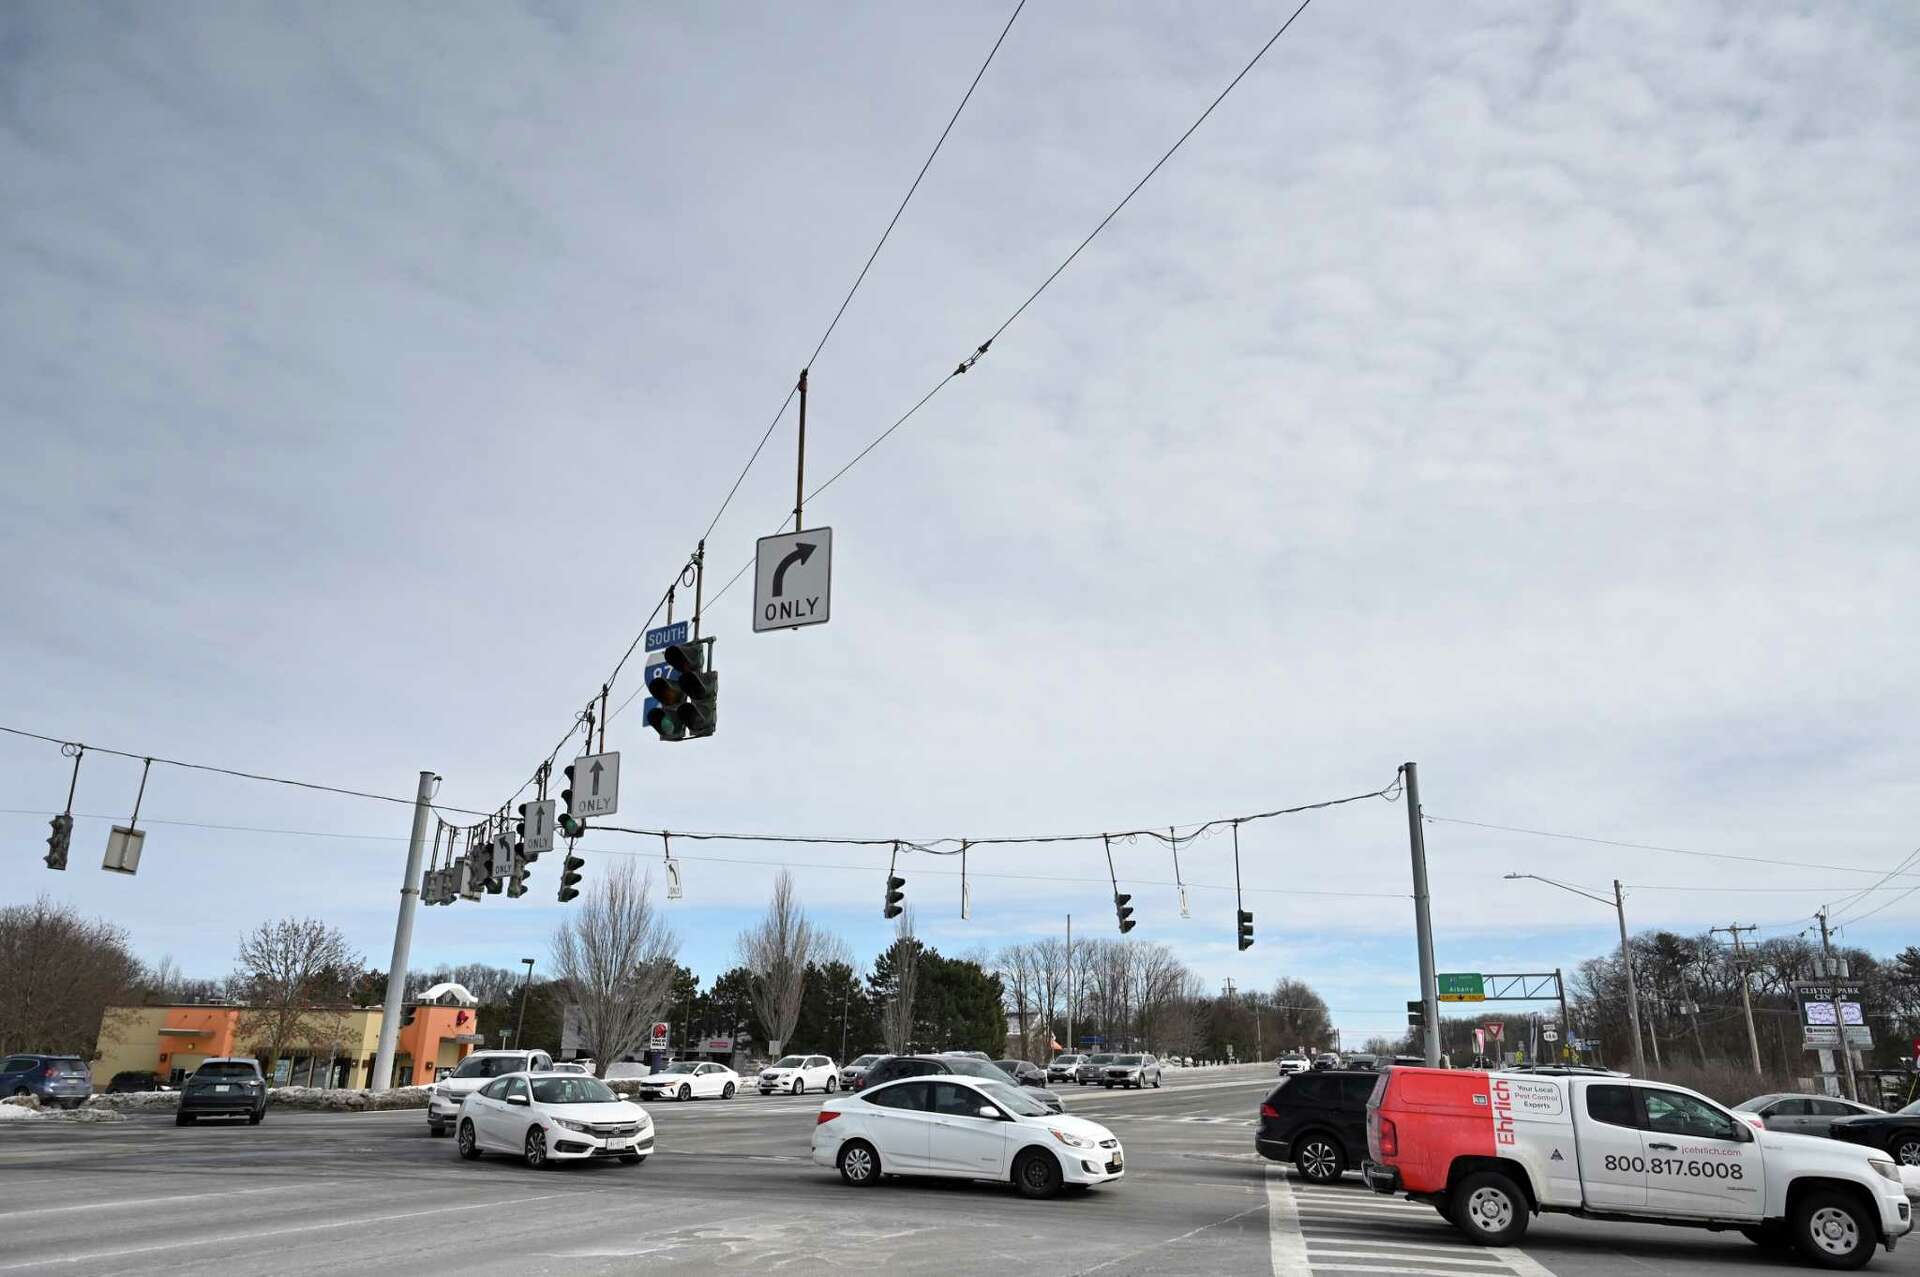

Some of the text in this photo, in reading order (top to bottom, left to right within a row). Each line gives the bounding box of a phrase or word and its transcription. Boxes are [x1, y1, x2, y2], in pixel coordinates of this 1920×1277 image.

[765, 597, 819, 621] ONLY
[647, 626, 686, 647] SOUTH
[578, 797, 612, 812] ONLY
[528, 838, 548, 849] ONLY
[496, 865, 511, 874] ONLY
[1532, 1094, 1558, 1102] Control
[1524, 1101, 1551, 1109] Experts
[1493, 1081, 1515, 1145] Ehrlich
[1681, 1145, 1741, 1157] jcehrlich.com
[1605, 1155, 1743, 1180] 800.817.6008
